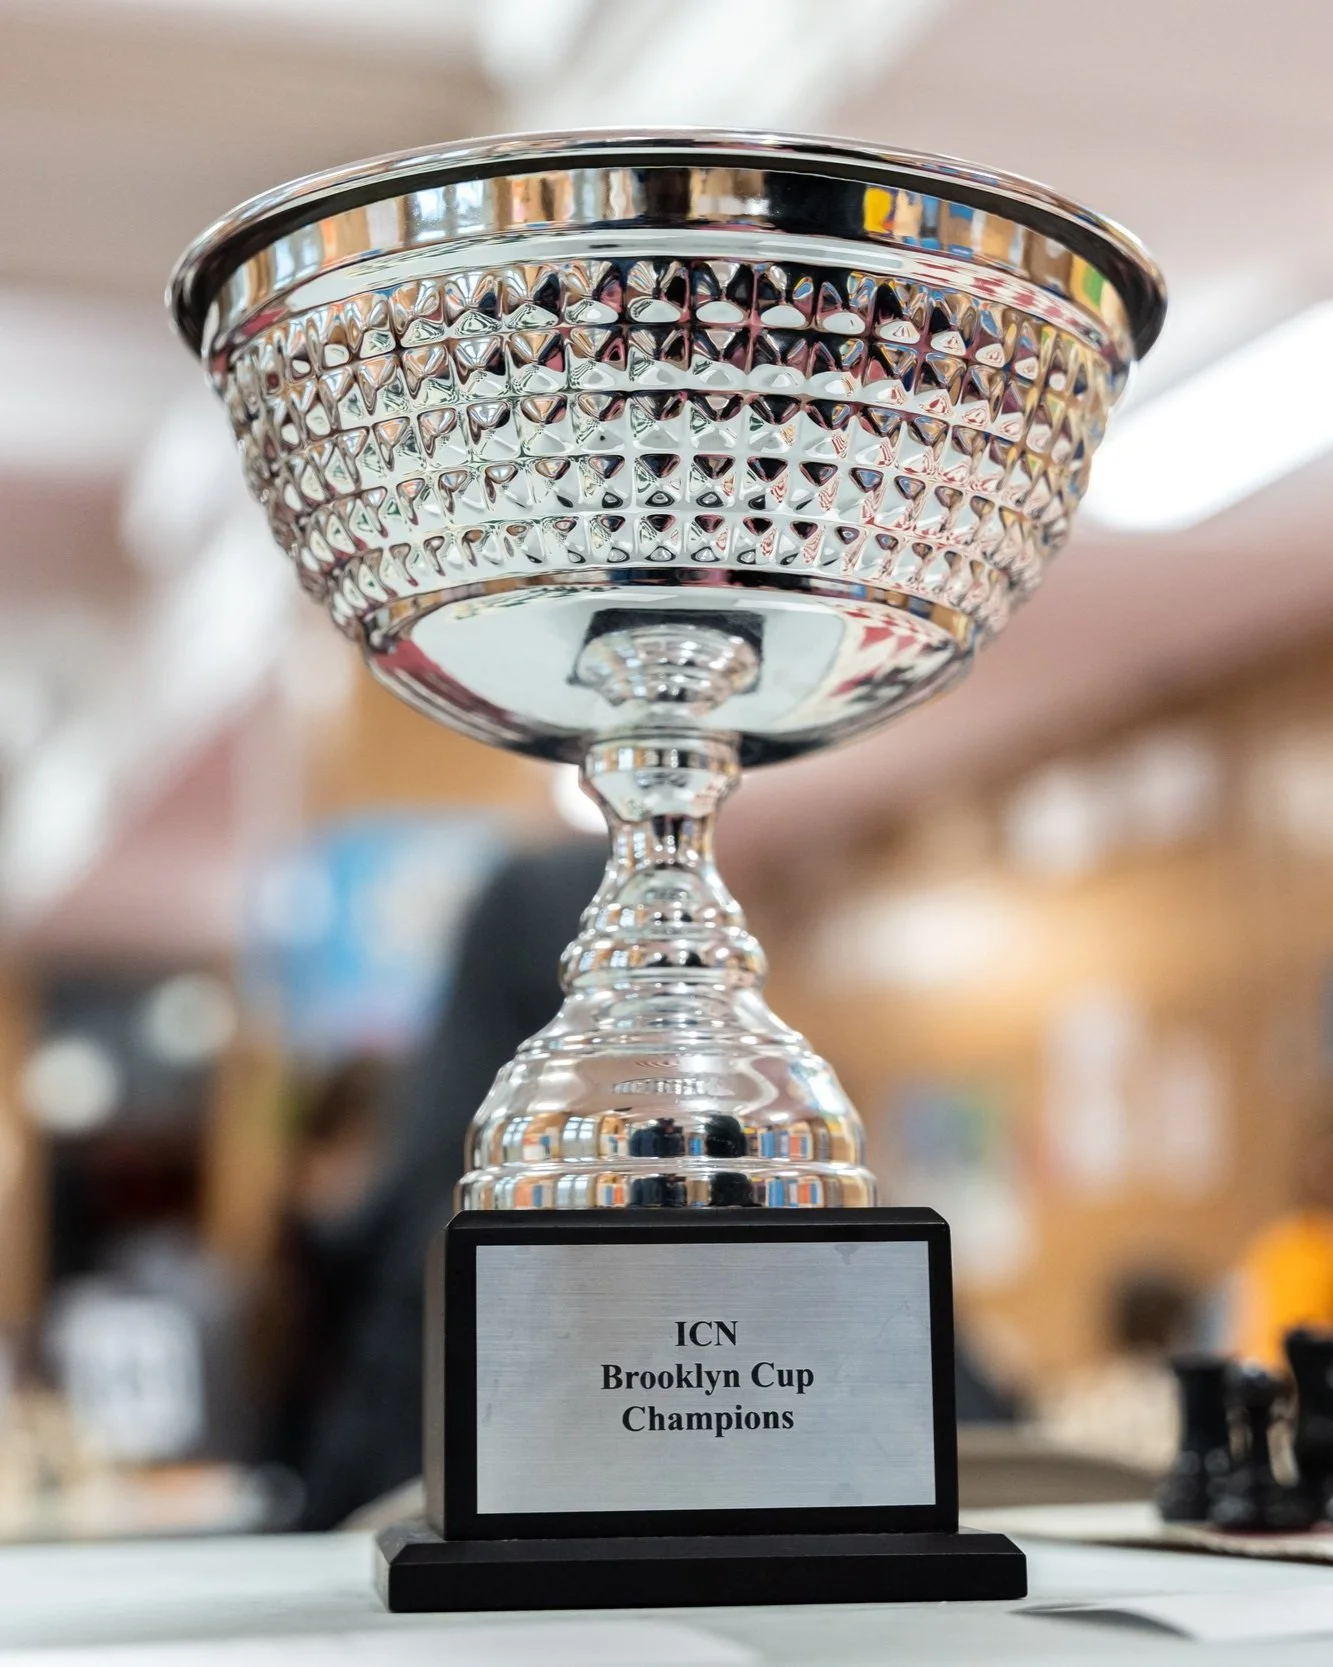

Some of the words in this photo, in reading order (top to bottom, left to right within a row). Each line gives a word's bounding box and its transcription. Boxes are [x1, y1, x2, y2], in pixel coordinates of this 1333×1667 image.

[674, 1320, 739, 1347] ICN
[600, 1362, 741, 1397] Brooklyn
[750, 1361, 815, 1395] Cup
[621, 1404, 795, 1438] Champions
